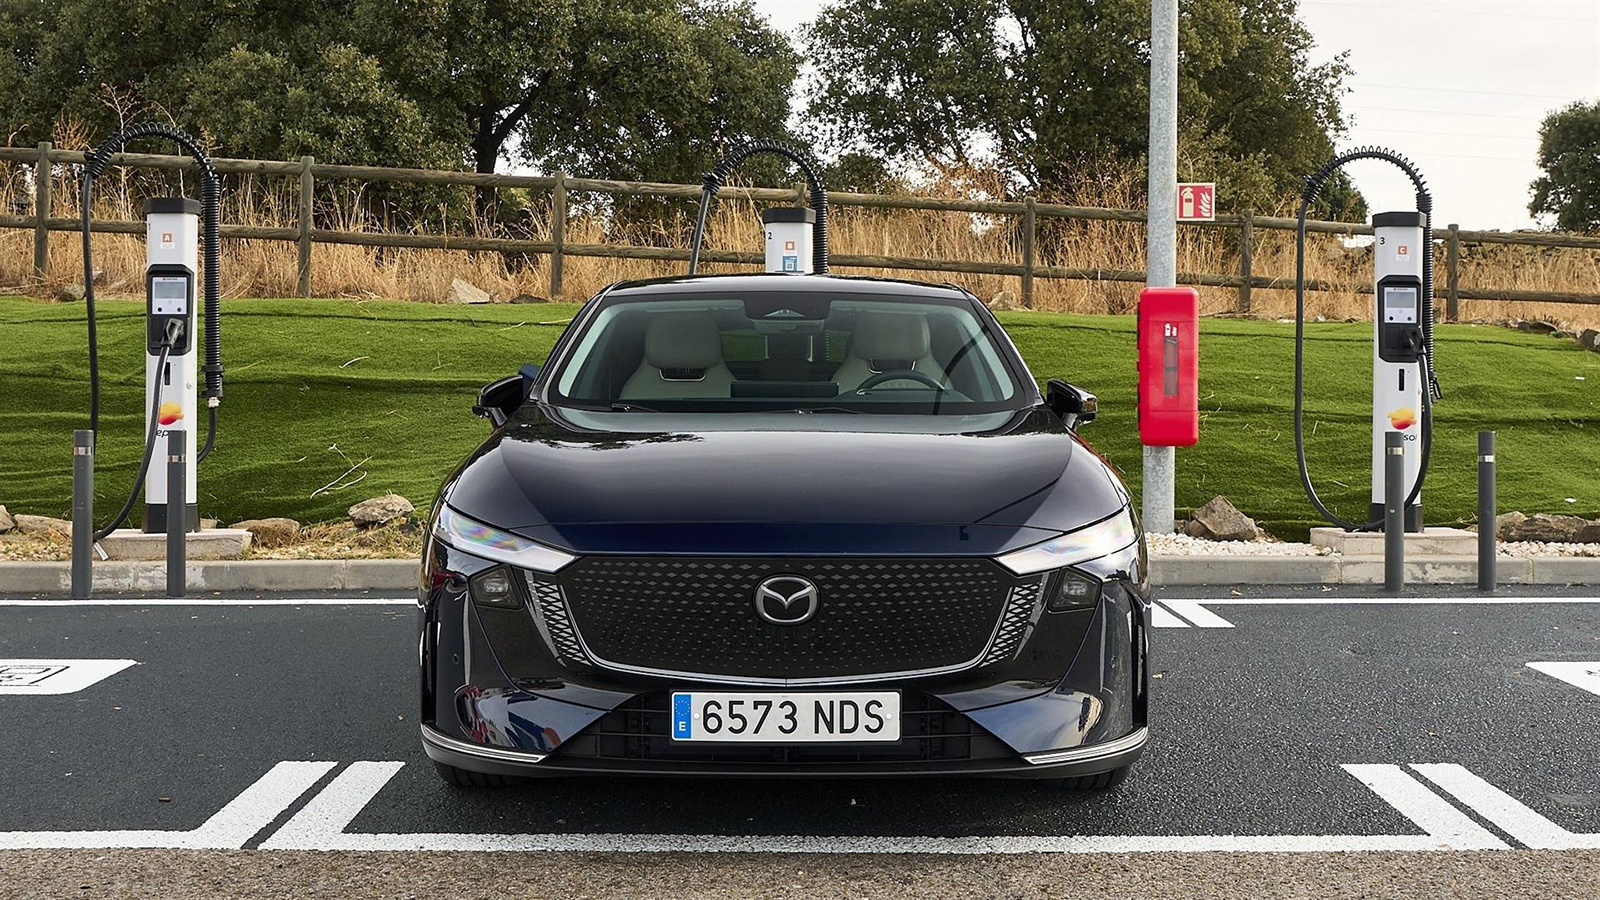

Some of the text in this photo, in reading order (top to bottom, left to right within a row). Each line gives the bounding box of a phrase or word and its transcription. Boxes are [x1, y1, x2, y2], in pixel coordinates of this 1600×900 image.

[767, 231, 773, 240] 2
[1379, 236, 1386, 245] 3
[702, 700, 884, 734] 6573 NDS
[678, 721, 687, 732] E
